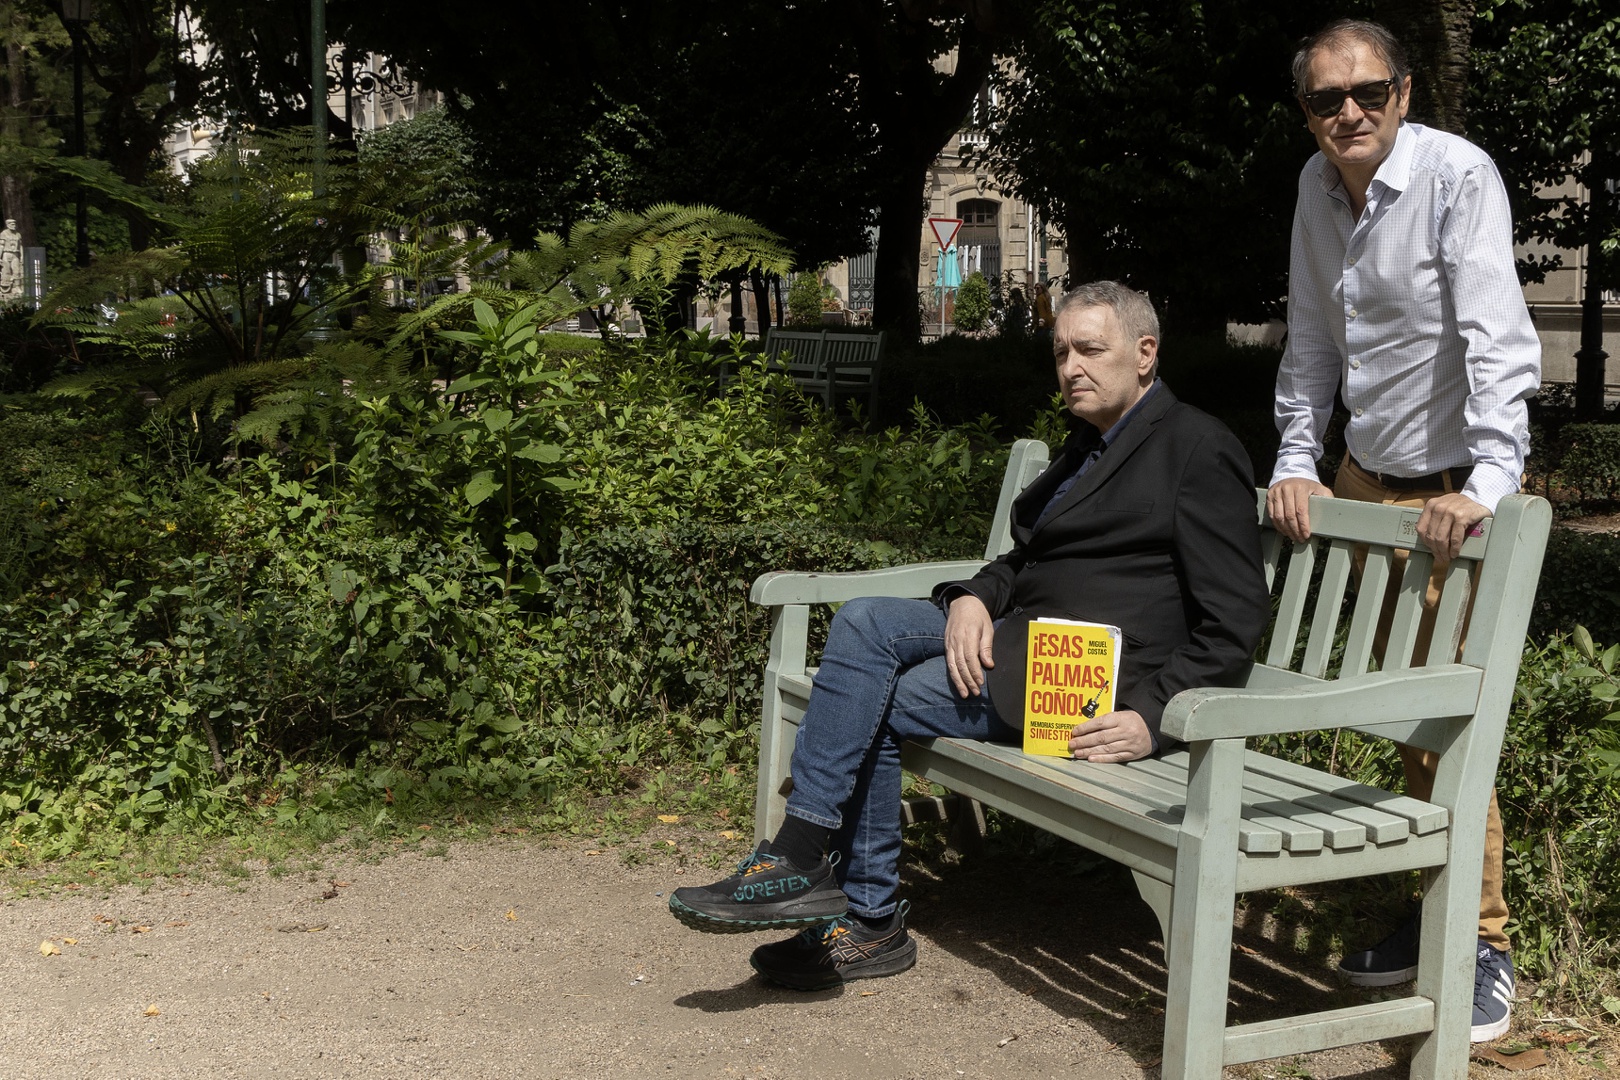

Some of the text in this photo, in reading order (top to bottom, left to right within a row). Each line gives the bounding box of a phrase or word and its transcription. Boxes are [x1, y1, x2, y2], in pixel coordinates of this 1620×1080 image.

[1033, 633, 1083, 658] ¡ESAS
[1032, 662, 1109, 693] PALMAS,
[1031, 688, 1083, 716] COÑO!
[1030, 721, 1054, 729] MEMORIAS
[733, 875, 812, 901] GORE-TEX
